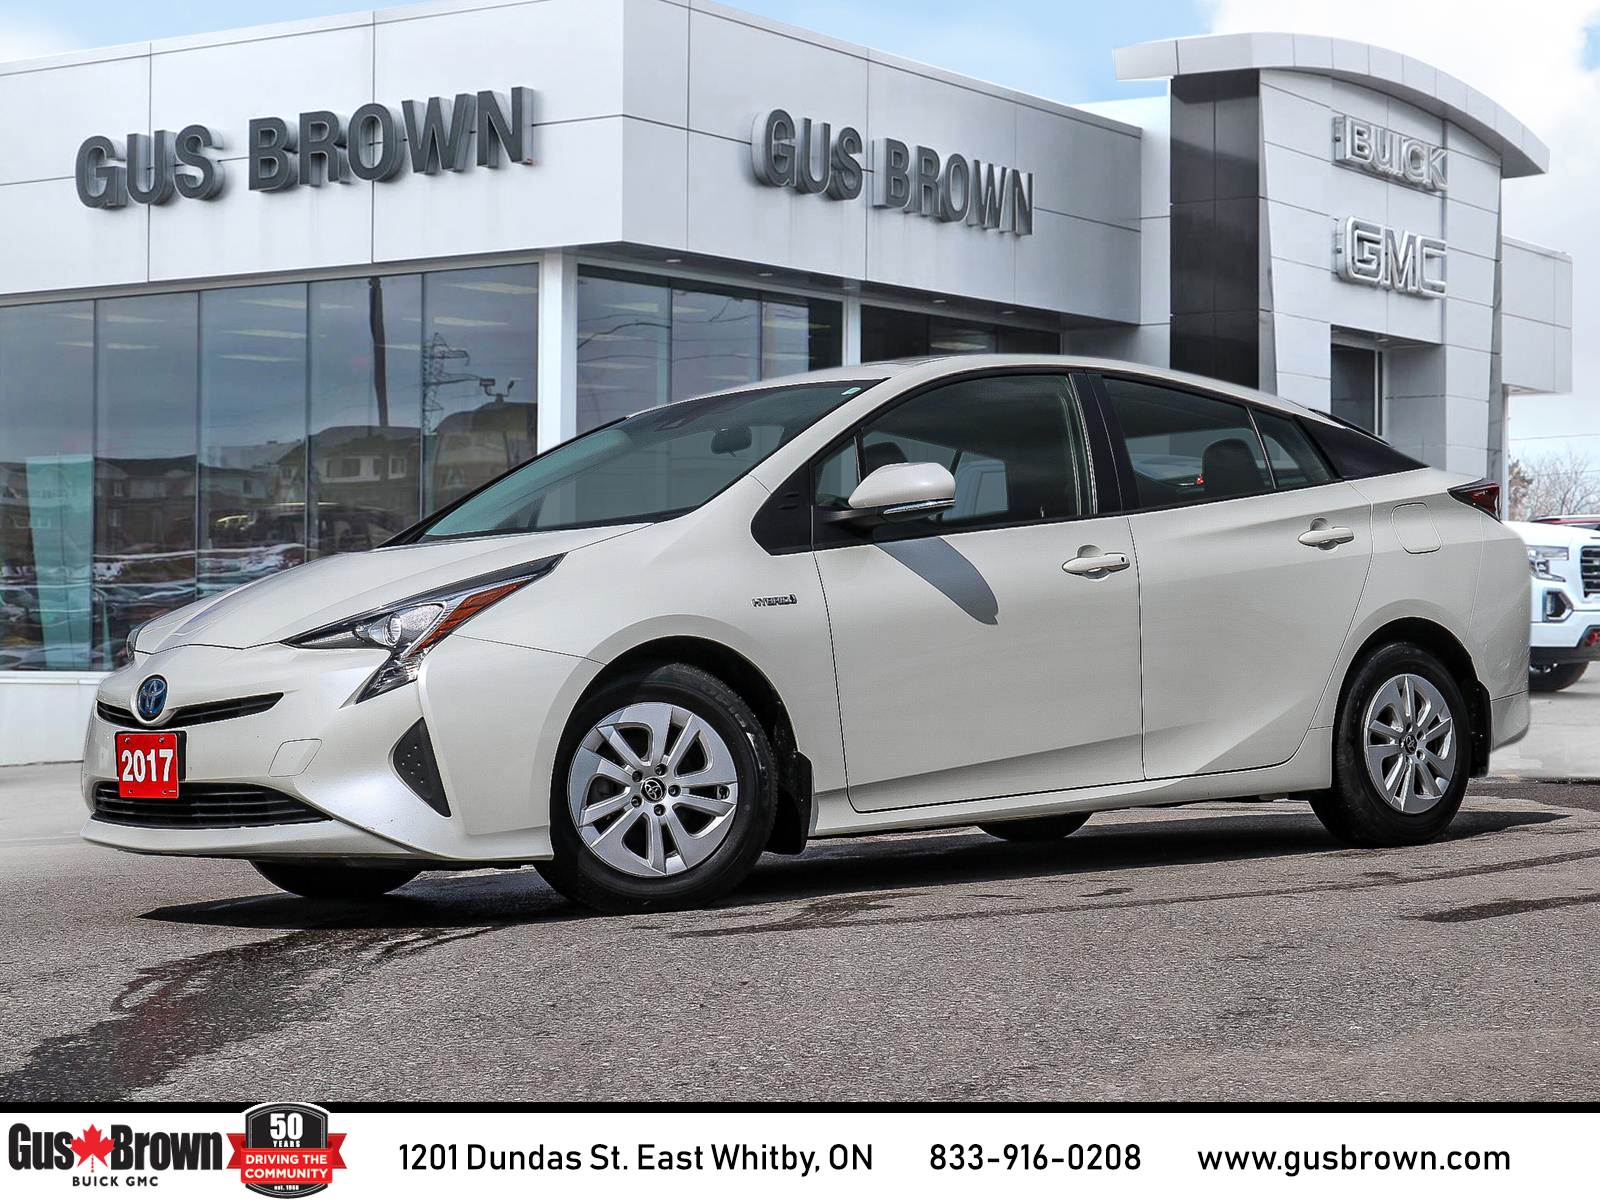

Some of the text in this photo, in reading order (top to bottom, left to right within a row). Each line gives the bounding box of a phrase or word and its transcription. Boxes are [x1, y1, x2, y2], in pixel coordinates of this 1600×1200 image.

[75, 85, 535, 210] GUS BROWN
[752, 108, 1035, 236] GUS BROWN
[1338, 115, 1448, 191] BUICK
[1340, 216, 1447, 299] GMC
[121, 748, 174, 782] 2017
